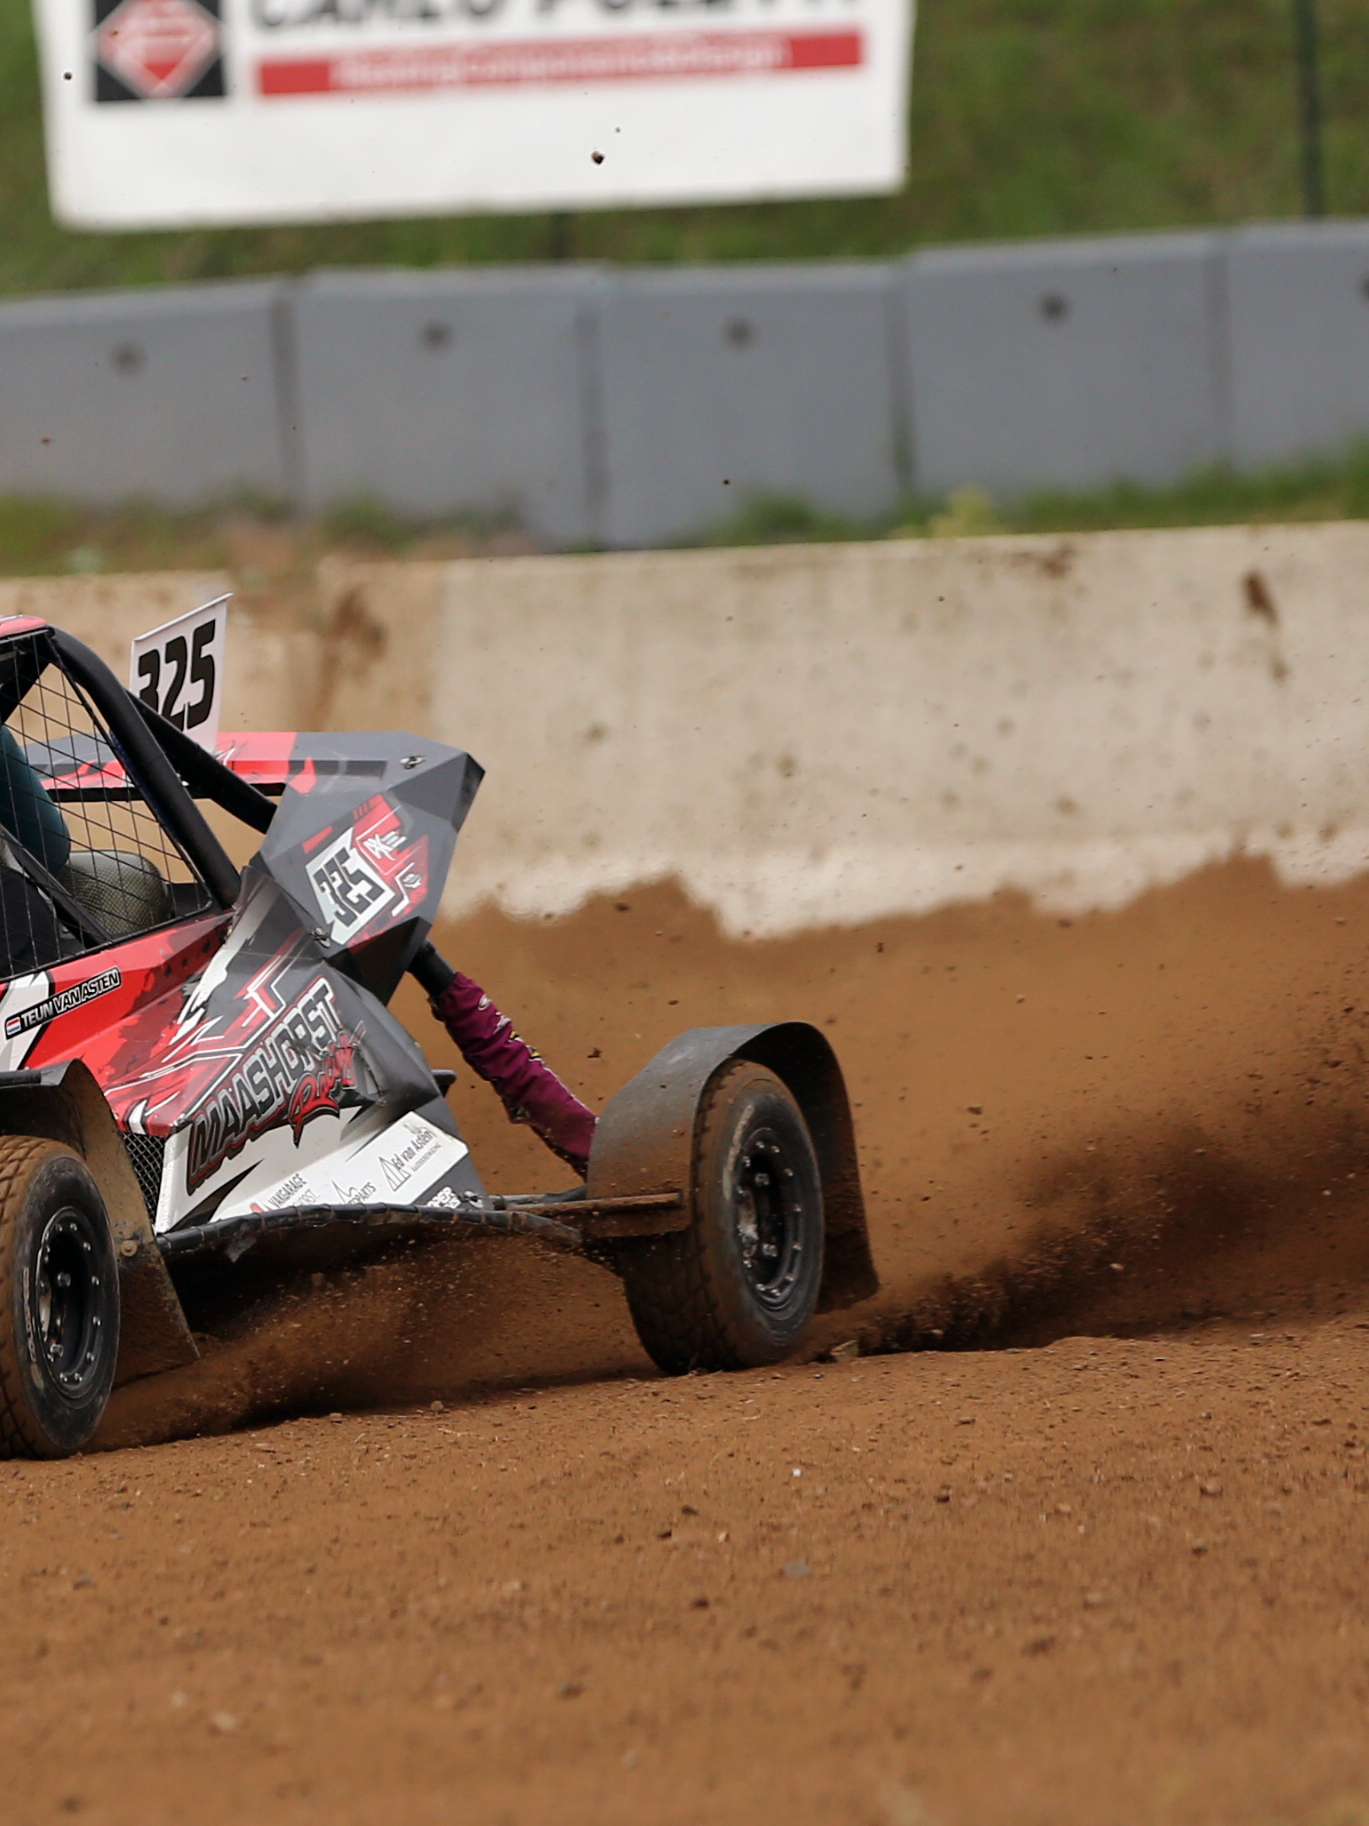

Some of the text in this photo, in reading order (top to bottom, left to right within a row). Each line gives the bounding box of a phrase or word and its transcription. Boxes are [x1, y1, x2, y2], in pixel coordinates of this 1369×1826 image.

[138, 619, 217, 733] 325
[312, 846, 386, 928] 325
[21, 967, 121, 1028] TEUN VAN ASTEN
[188, 978, 339, 1186] MAASHORST
[390, 1153, 404, 1169] Ed
[400, 1145, 416, 1162] van
